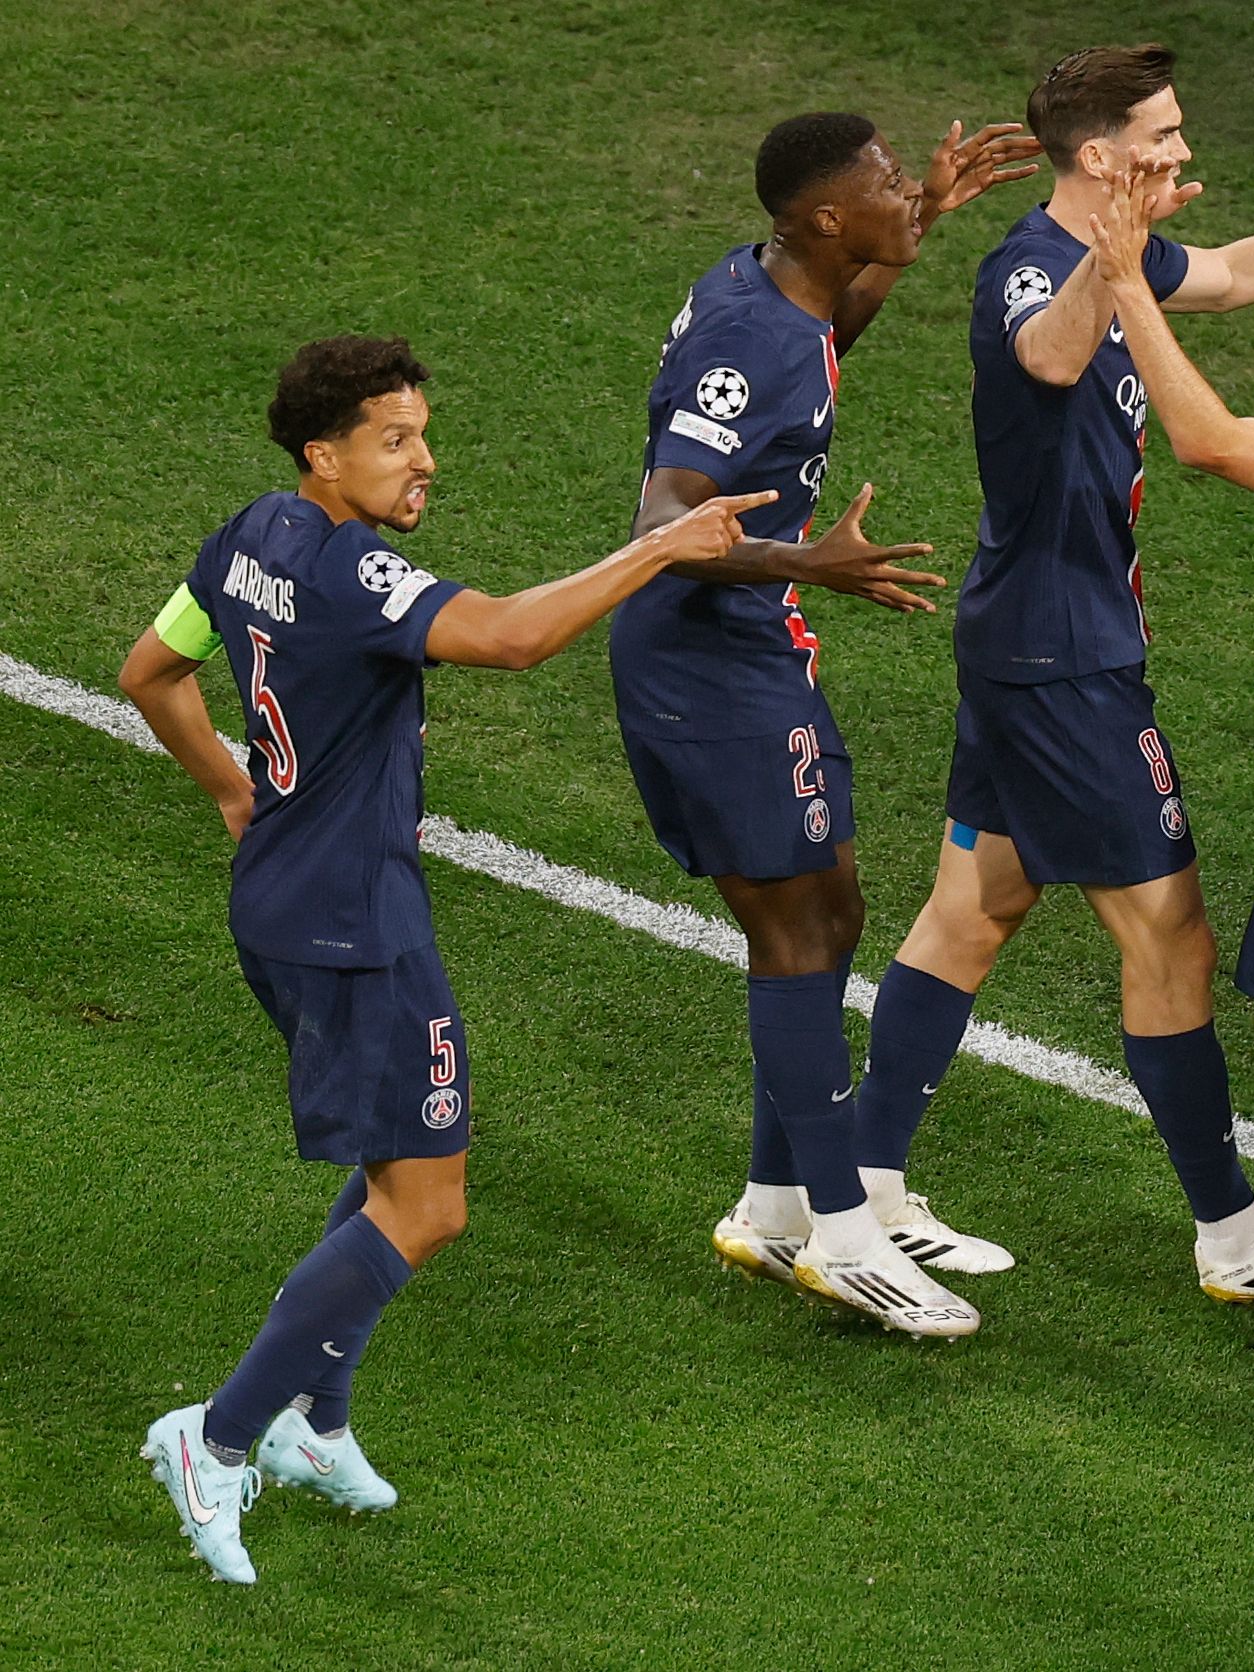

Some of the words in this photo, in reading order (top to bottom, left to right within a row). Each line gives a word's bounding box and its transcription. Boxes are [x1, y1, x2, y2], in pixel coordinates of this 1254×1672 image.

[247, 623, 298, 797] 5
[1138, 727, 1173, 795] 8
[428, 1016, 457, 1087] 5
[903, 1308, 971, 1323] F50
